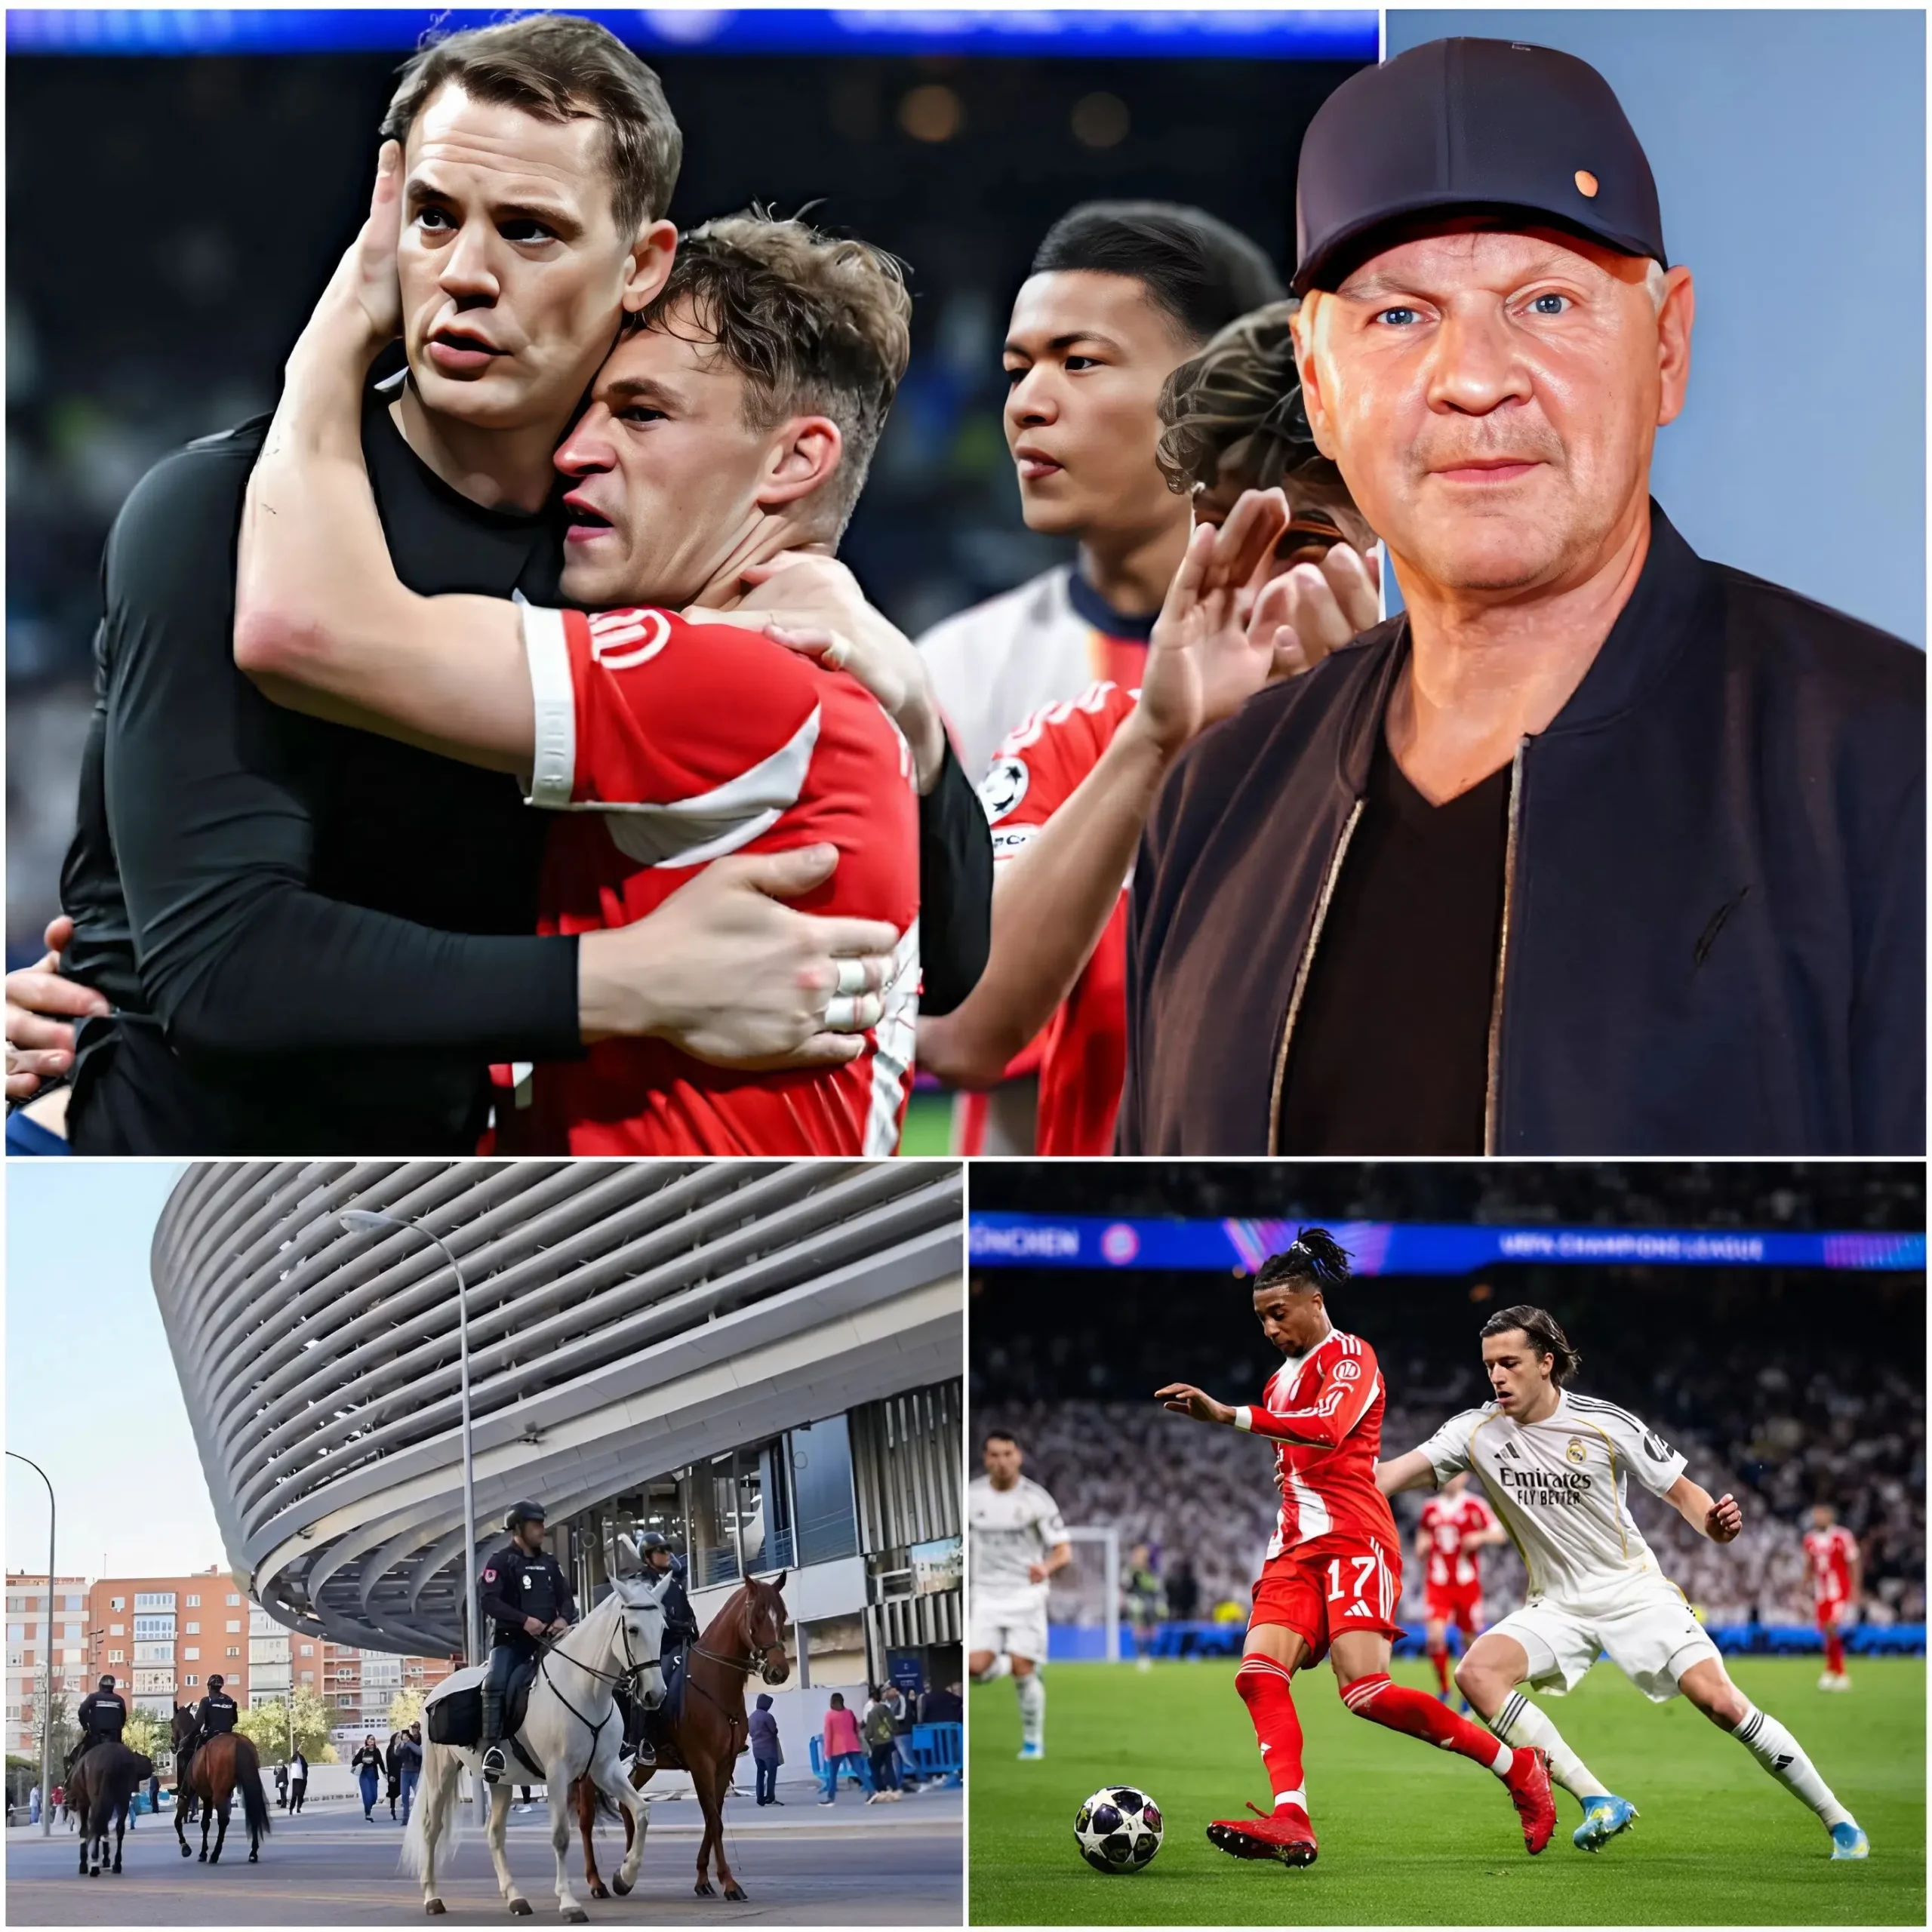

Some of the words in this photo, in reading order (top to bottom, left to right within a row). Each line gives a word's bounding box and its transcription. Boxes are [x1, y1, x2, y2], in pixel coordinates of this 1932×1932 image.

[1500, 1467, 1591, 1489] Emirates
[1518, 1489, 1536, 1506] FLY
[1540, 1489, 1580, 1506] BETTER
[1327, 1556, 1376, 1602] 17
